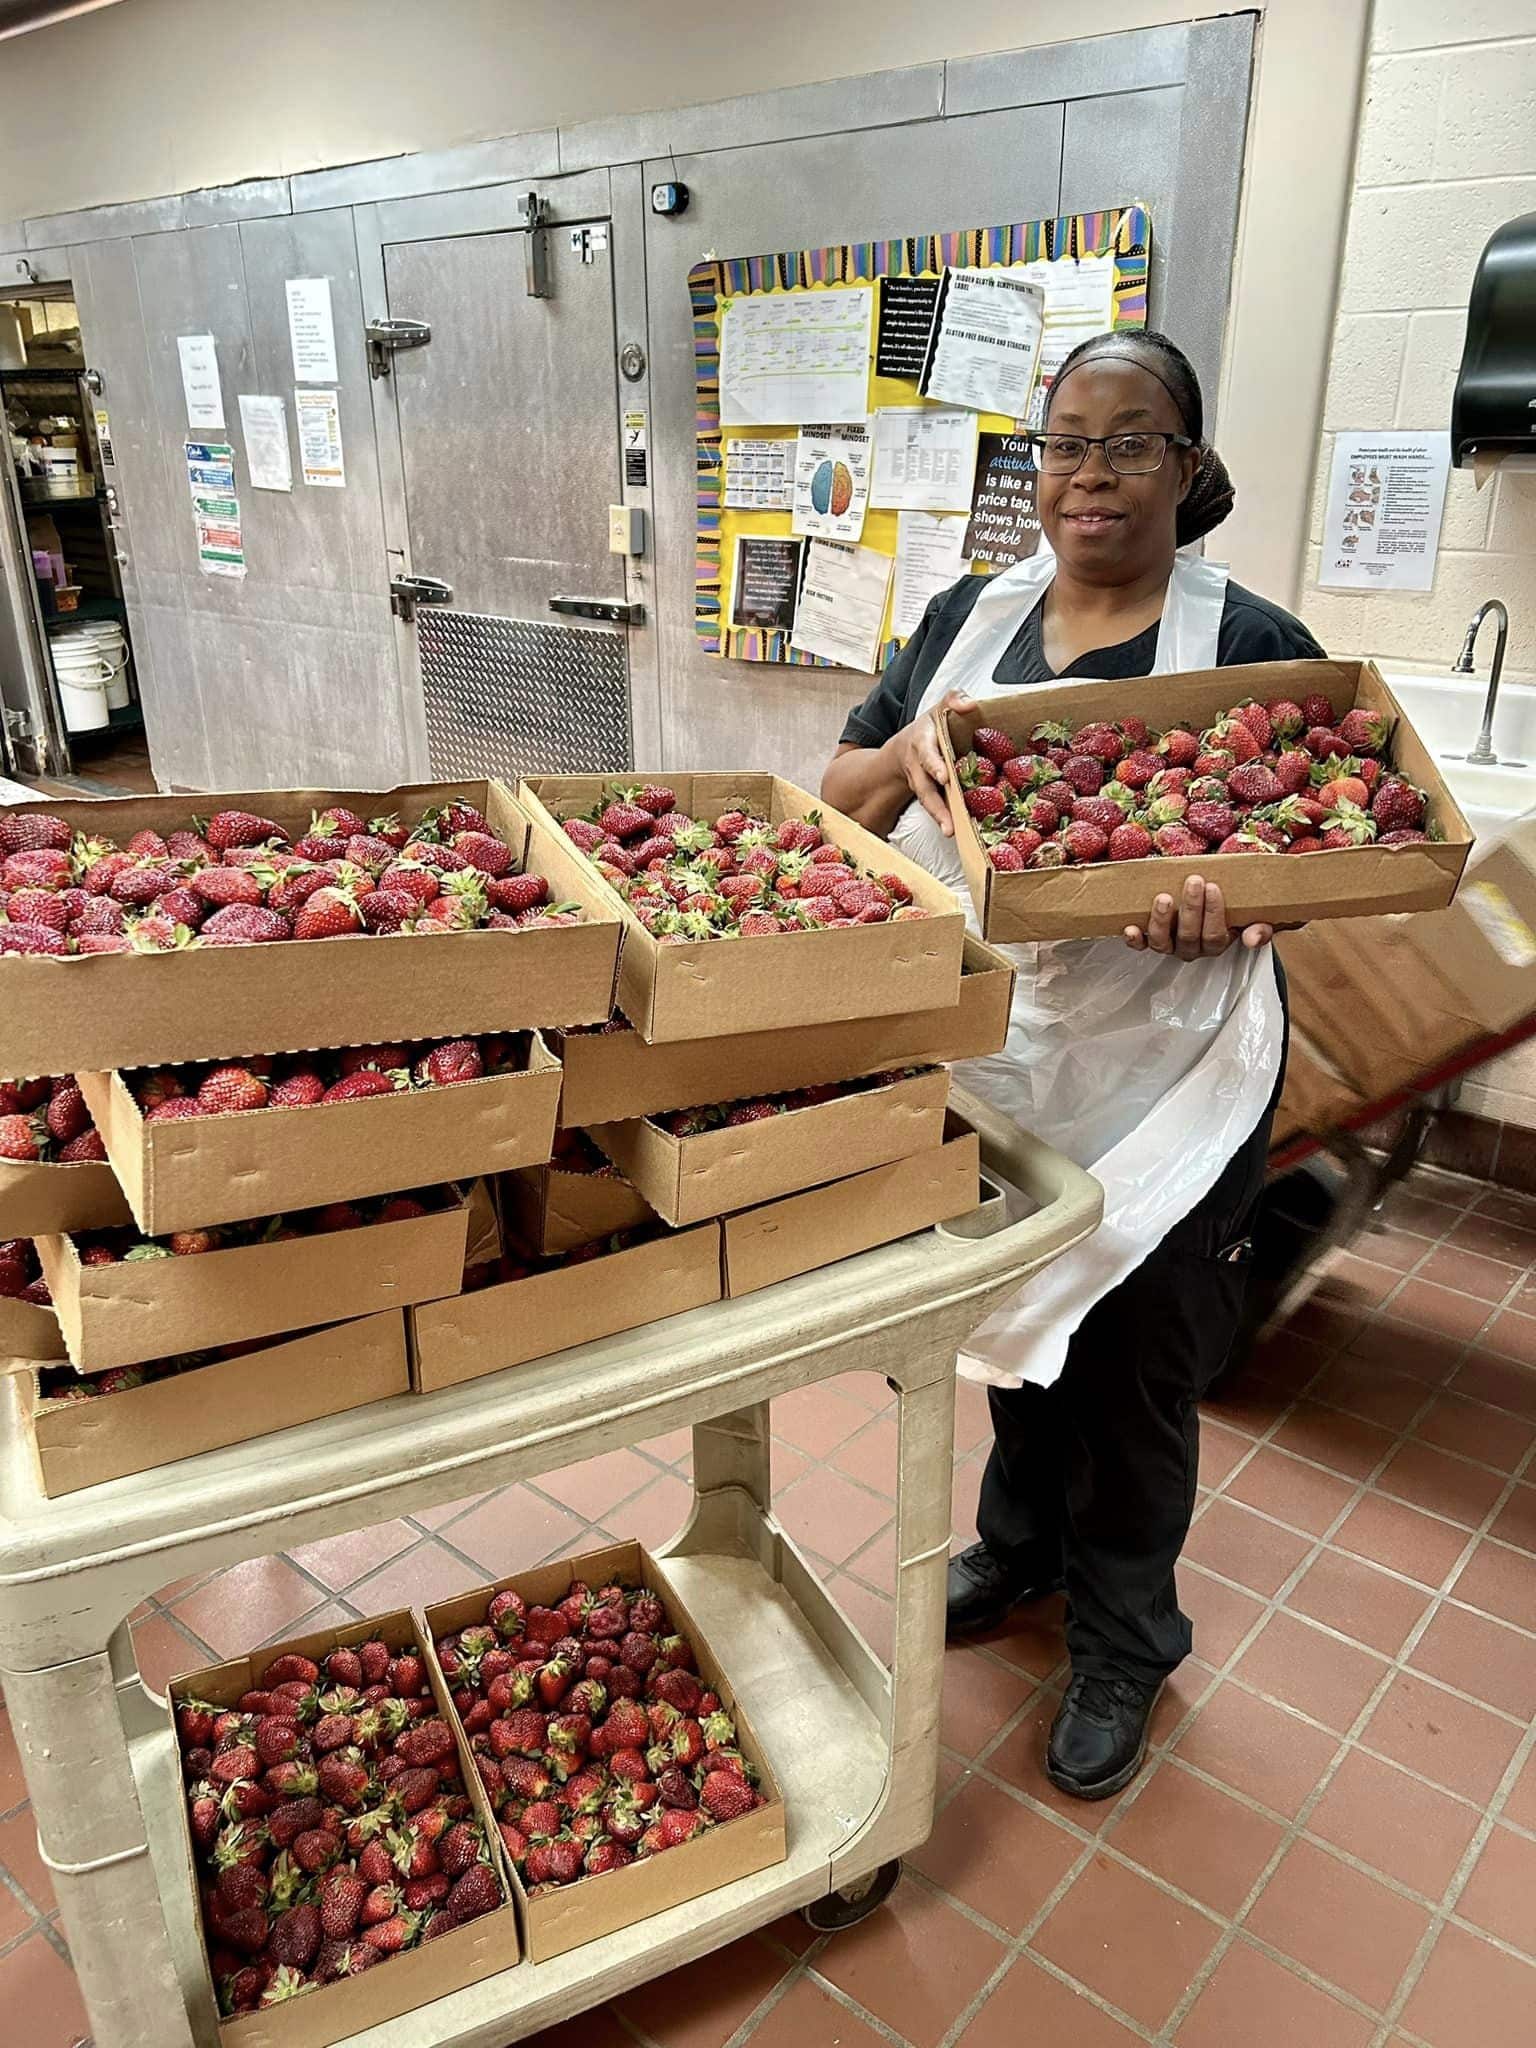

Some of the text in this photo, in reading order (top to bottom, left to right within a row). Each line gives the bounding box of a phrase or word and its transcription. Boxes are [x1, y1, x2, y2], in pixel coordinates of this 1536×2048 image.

[1001, 437, 1030, 452] Your
[985, 474, 1033, 491] is like a
[977, 493, 1034, 512] price tag,
[973, 512, 1041, 529] shows how
[974, 527, 1022, 545] valuable
[969, 548, 1018, 564] you are.
